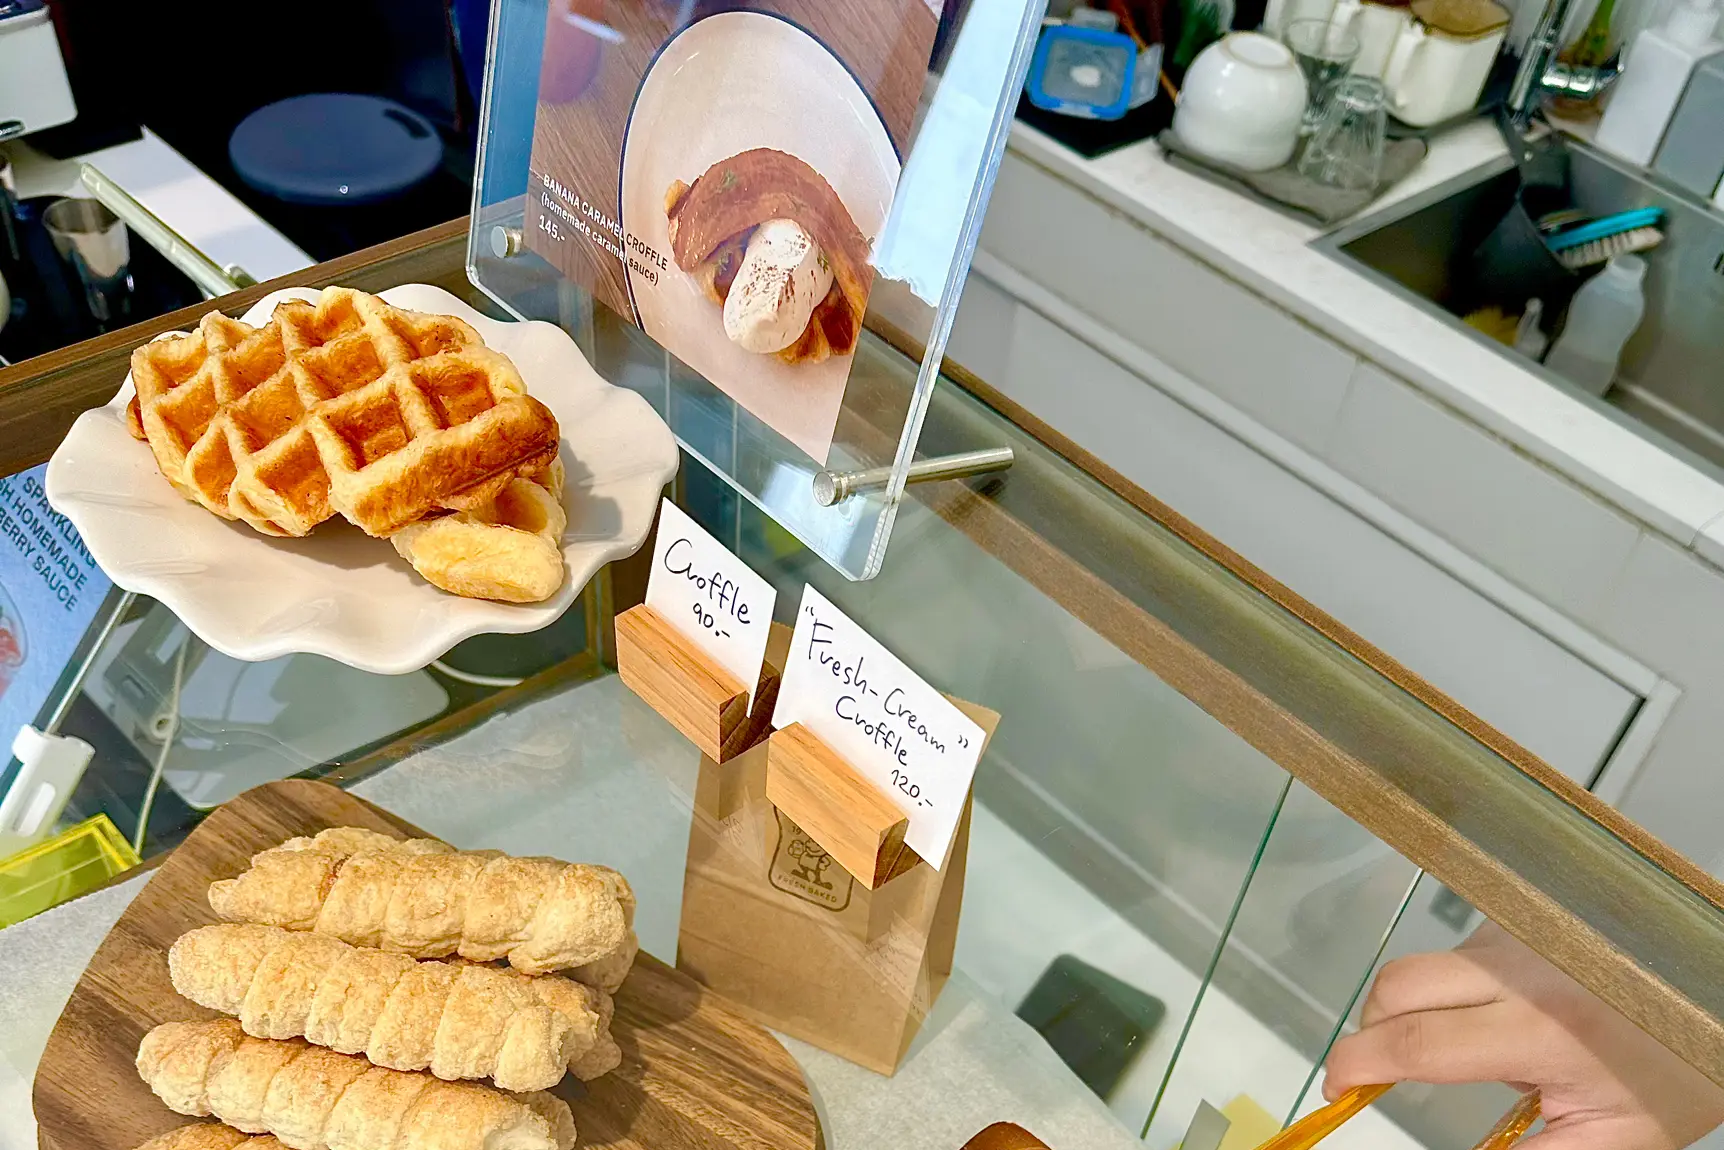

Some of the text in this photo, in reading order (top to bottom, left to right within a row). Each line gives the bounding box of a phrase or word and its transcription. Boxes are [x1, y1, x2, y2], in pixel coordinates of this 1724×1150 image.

[539, 214, 566, 243] 145.-
[541, 192, 659, 286] (homemade caramel sauce)
[543, 174, 668, 271] BANANA CARAMEL CROFFLE
[12, 496, 87, 591] HOMEMADE
[33, 555, 78, 612] SAUCE
[663, 537, 751, 624] Croffle
[692, 602, 731, 639] 90.-
[835, 696, 908, 767] Croffle
[890, 769, 934, 809] 120.-
[808, 886, 837, 903] BAKED
